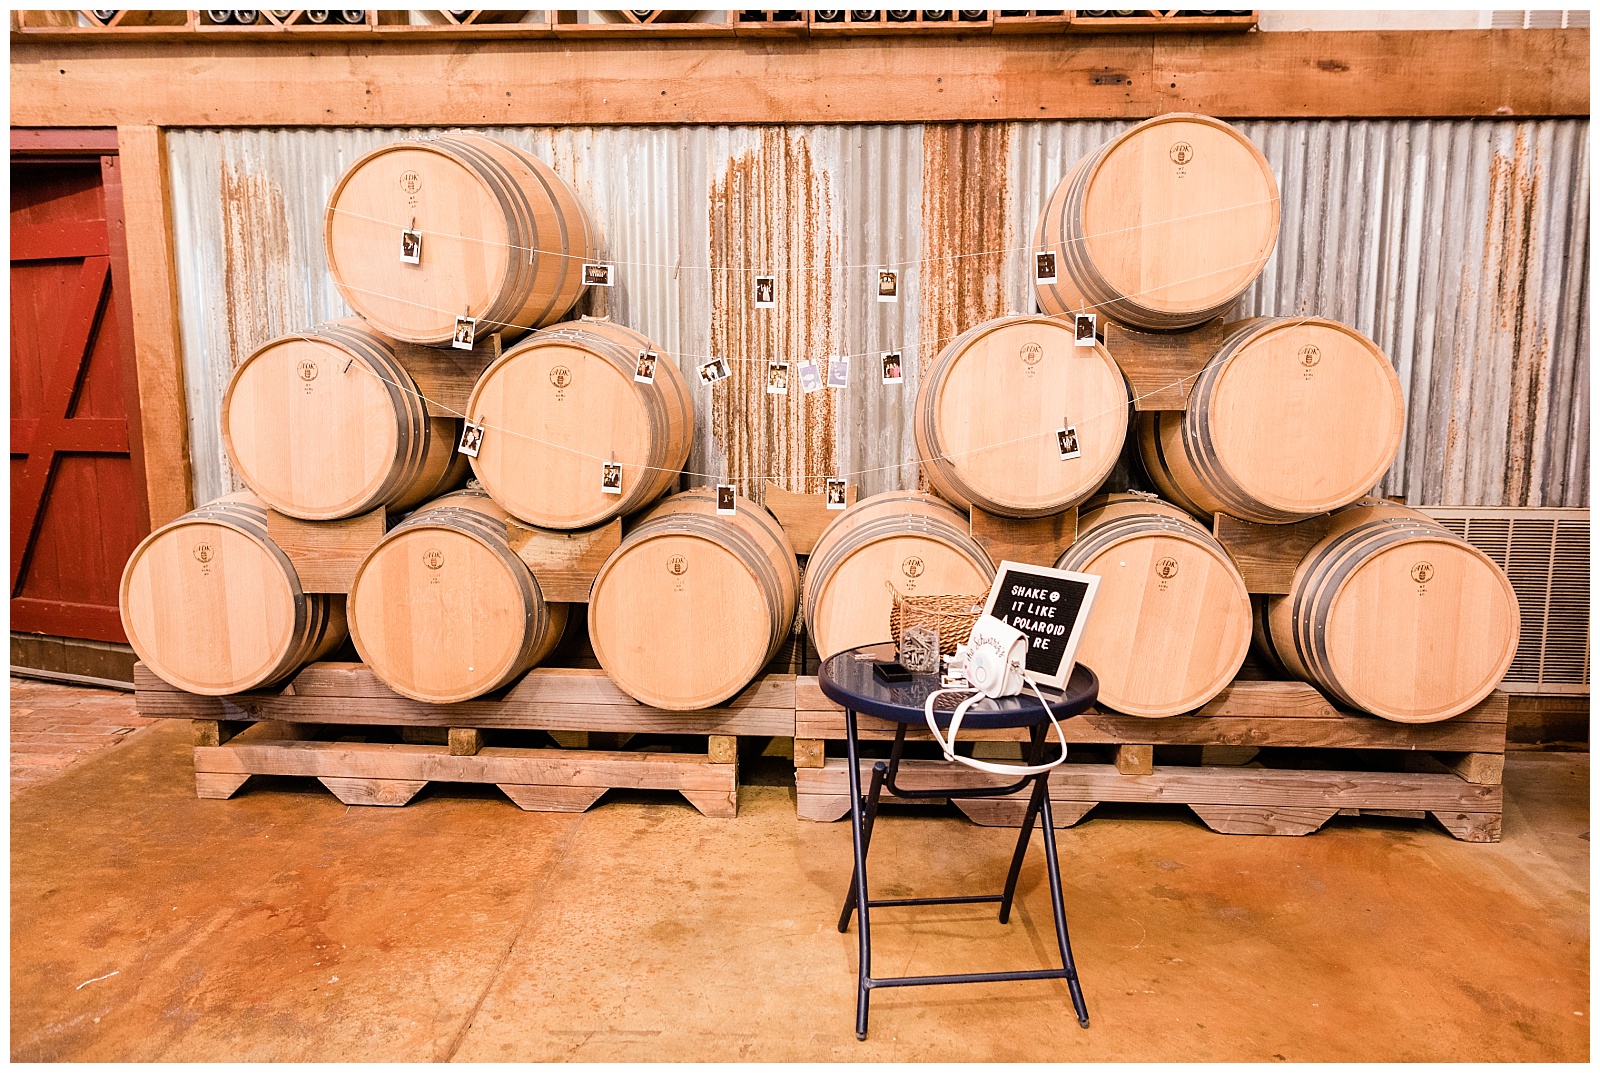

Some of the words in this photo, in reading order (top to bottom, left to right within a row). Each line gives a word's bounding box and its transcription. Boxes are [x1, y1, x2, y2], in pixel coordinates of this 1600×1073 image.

[1011, 585, 1049, 601] SHAKE
[1011, 601, 1025, 612] IT
[1027, 602, 1057, 618] LIKE
[1012, 616, 1066, 636] POLAROID
